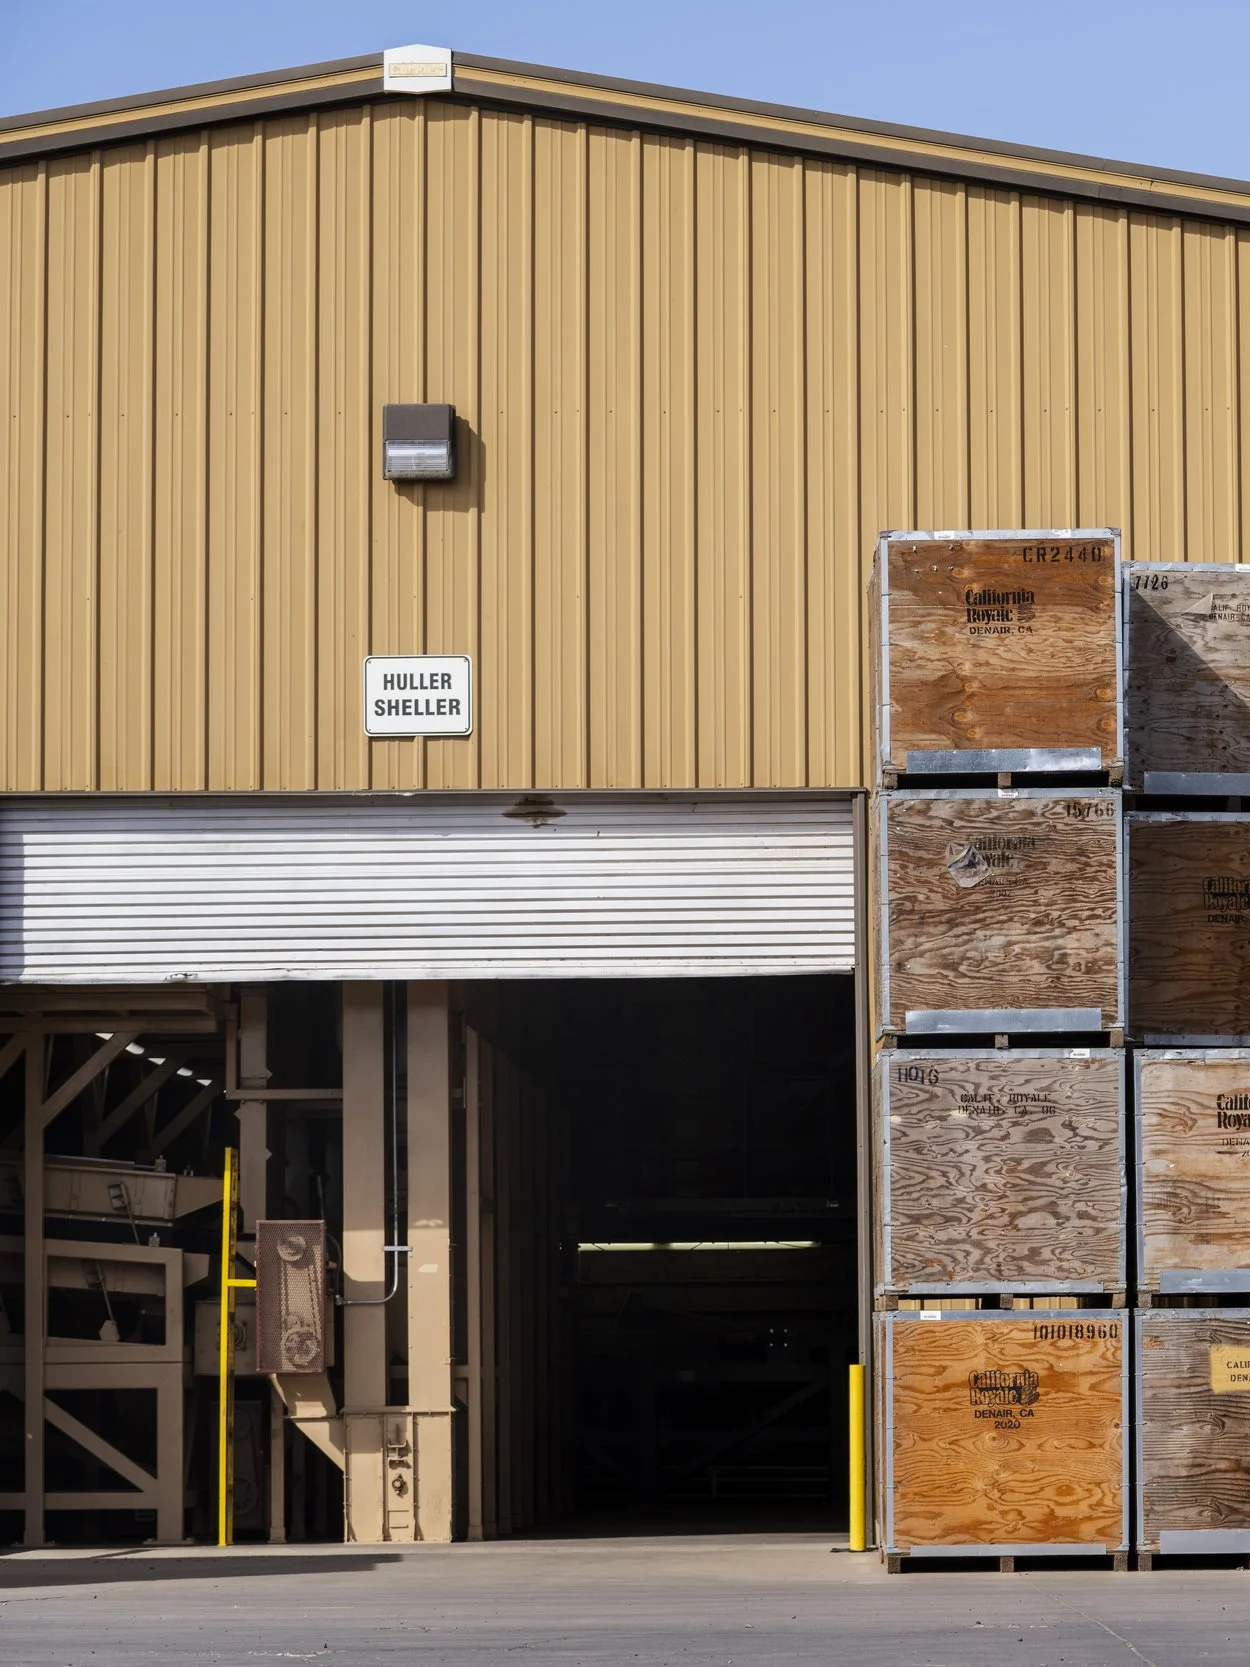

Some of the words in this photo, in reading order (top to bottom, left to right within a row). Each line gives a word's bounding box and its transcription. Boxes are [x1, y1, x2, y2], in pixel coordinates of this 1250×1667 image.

[1023, 546, 1101, 563] CR2440
[965, 588, 1035, 606] California
[966, 606, 1013, 625] Royale
[1018, 625, 1033, 634] CA
[383, 672, 452, 690] HULLER
[374, 698, 461, 716] SHELLER
[1203, 893, 1249, 912] Royale
[968, 1369, 1040, 1388] California
[970, 1387, 1018, 1408] Royale
[974, 1409, 1016, 1419] DENAIR,
[1019, 1409, 1034, 1418] CA
[994, 1420, 1021, 1429] 2020
